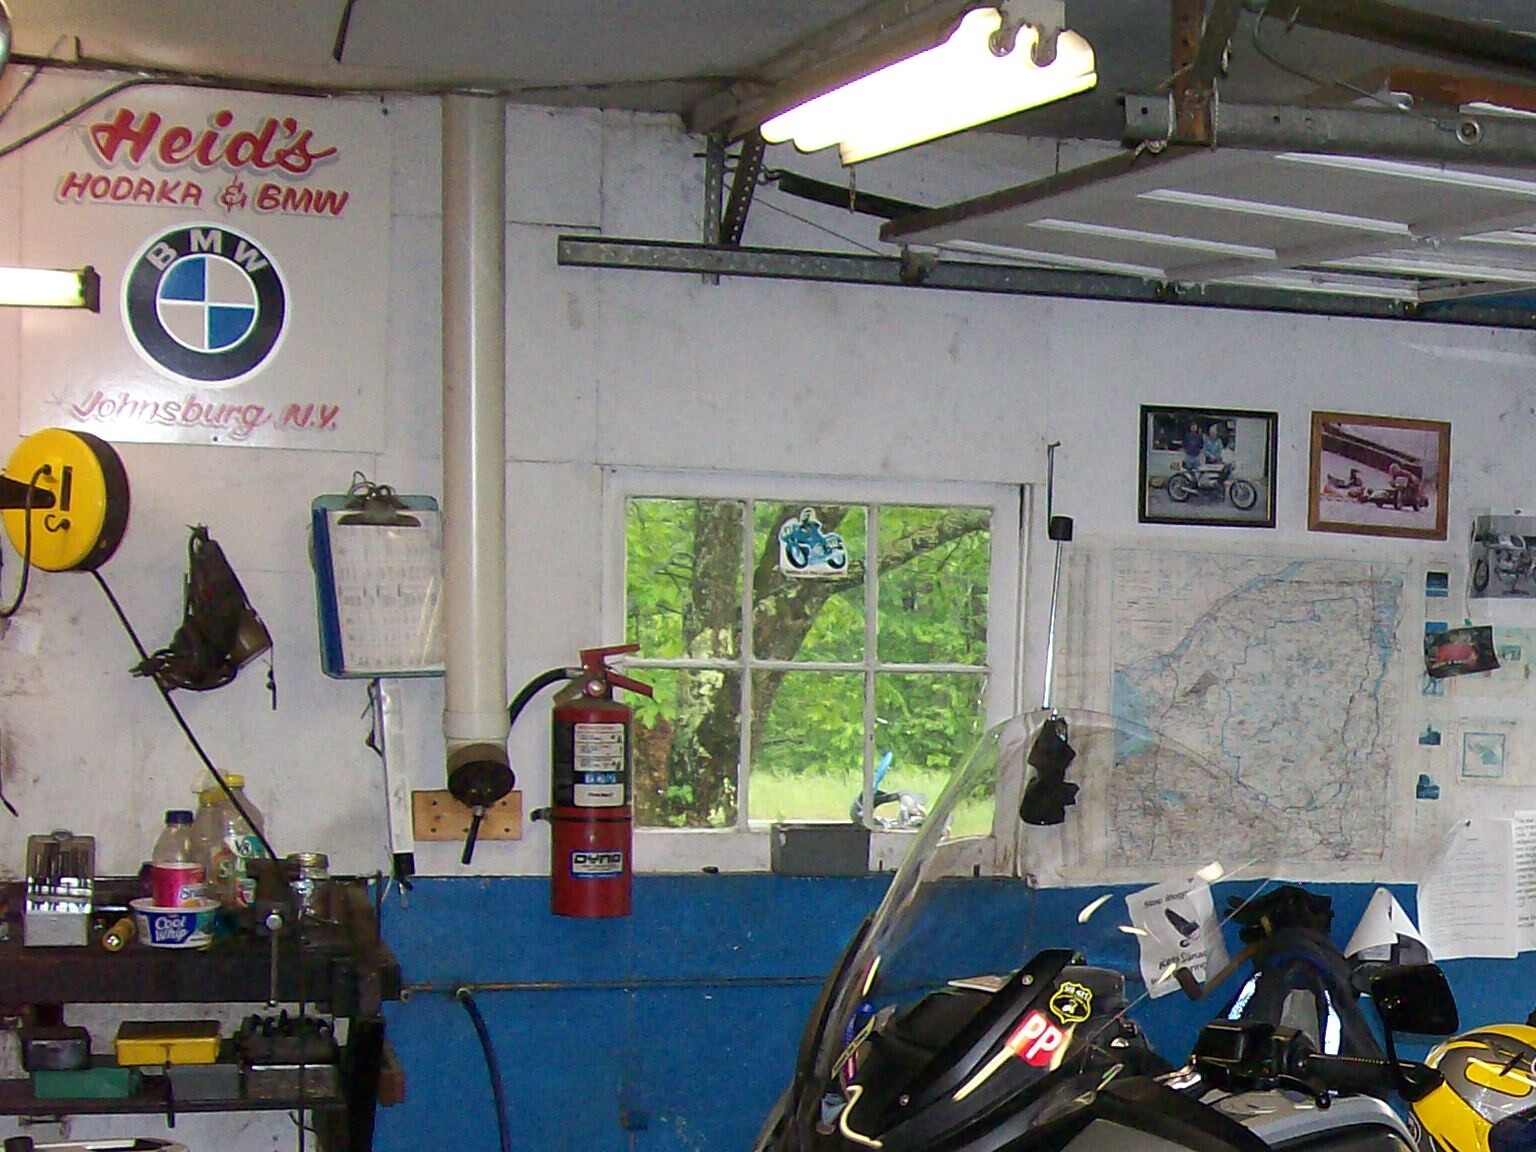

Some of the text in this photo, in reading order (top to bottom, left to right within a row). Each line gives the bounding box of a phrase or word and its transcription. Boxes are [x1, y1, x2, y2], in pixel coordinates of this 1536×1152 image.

[89, 107, 338, 174] Heid's
[60, 171, 350, 215] HODAKA & BMW
[145, 228, 270, 274] BMW
[154, 914, 187, 931] Cool
[155, 926, 188, 943] Whip
